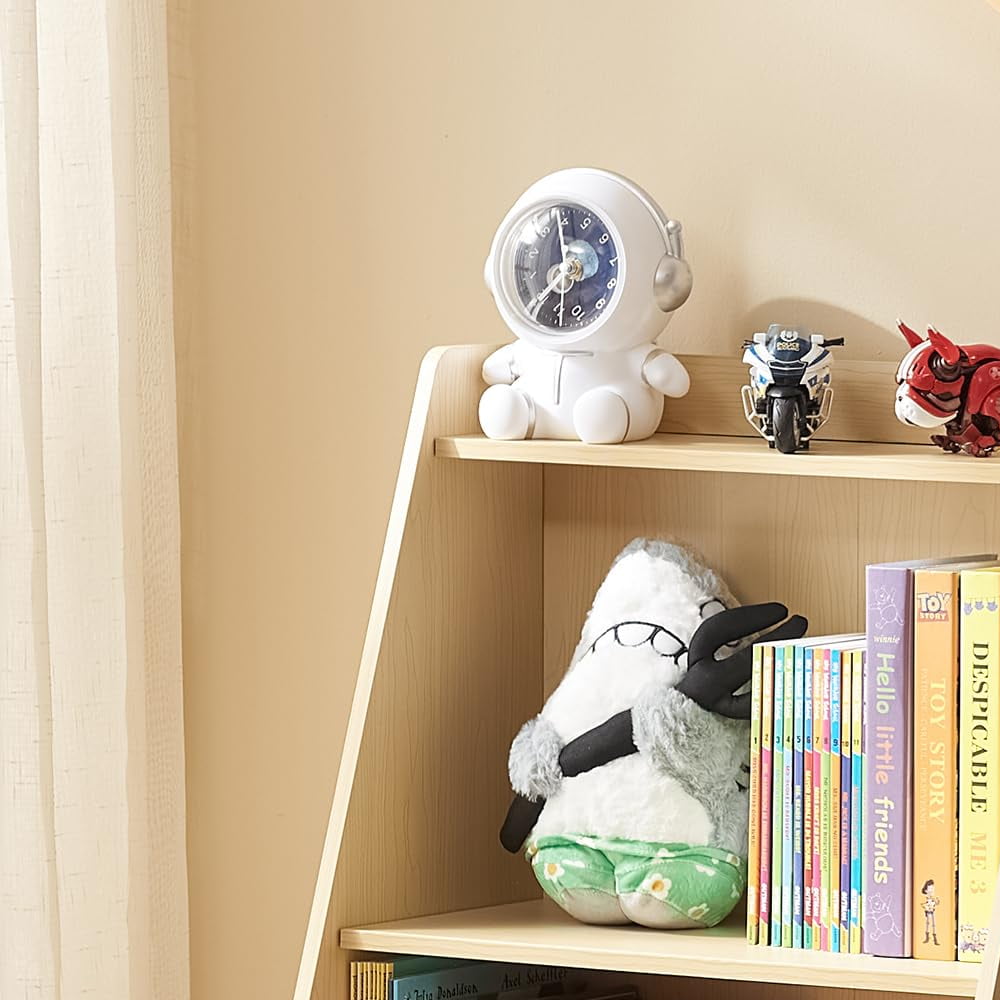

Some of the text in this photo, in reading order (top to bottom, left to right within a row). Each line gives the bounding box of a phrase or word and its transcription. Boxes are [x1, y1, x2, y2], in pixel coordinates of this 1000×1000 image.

[580, 218, 591, 230] 5
[598, 233, 608, 244] 6
[607, 278, 616, 289] 8
[571, 305, 585, 321] 10
[917, 592, 952, 612] TOY
[919, 612, 947, 620] STORY
[929, 678, 946, 823] TOY STORY
[873, 652, 896, 884] Hello little friends
[969, 642, 989, 895] DESPICABLE ME 3
[437, 983, 478, 999] Donaldson
[501, 972, 521, 990] Axel
